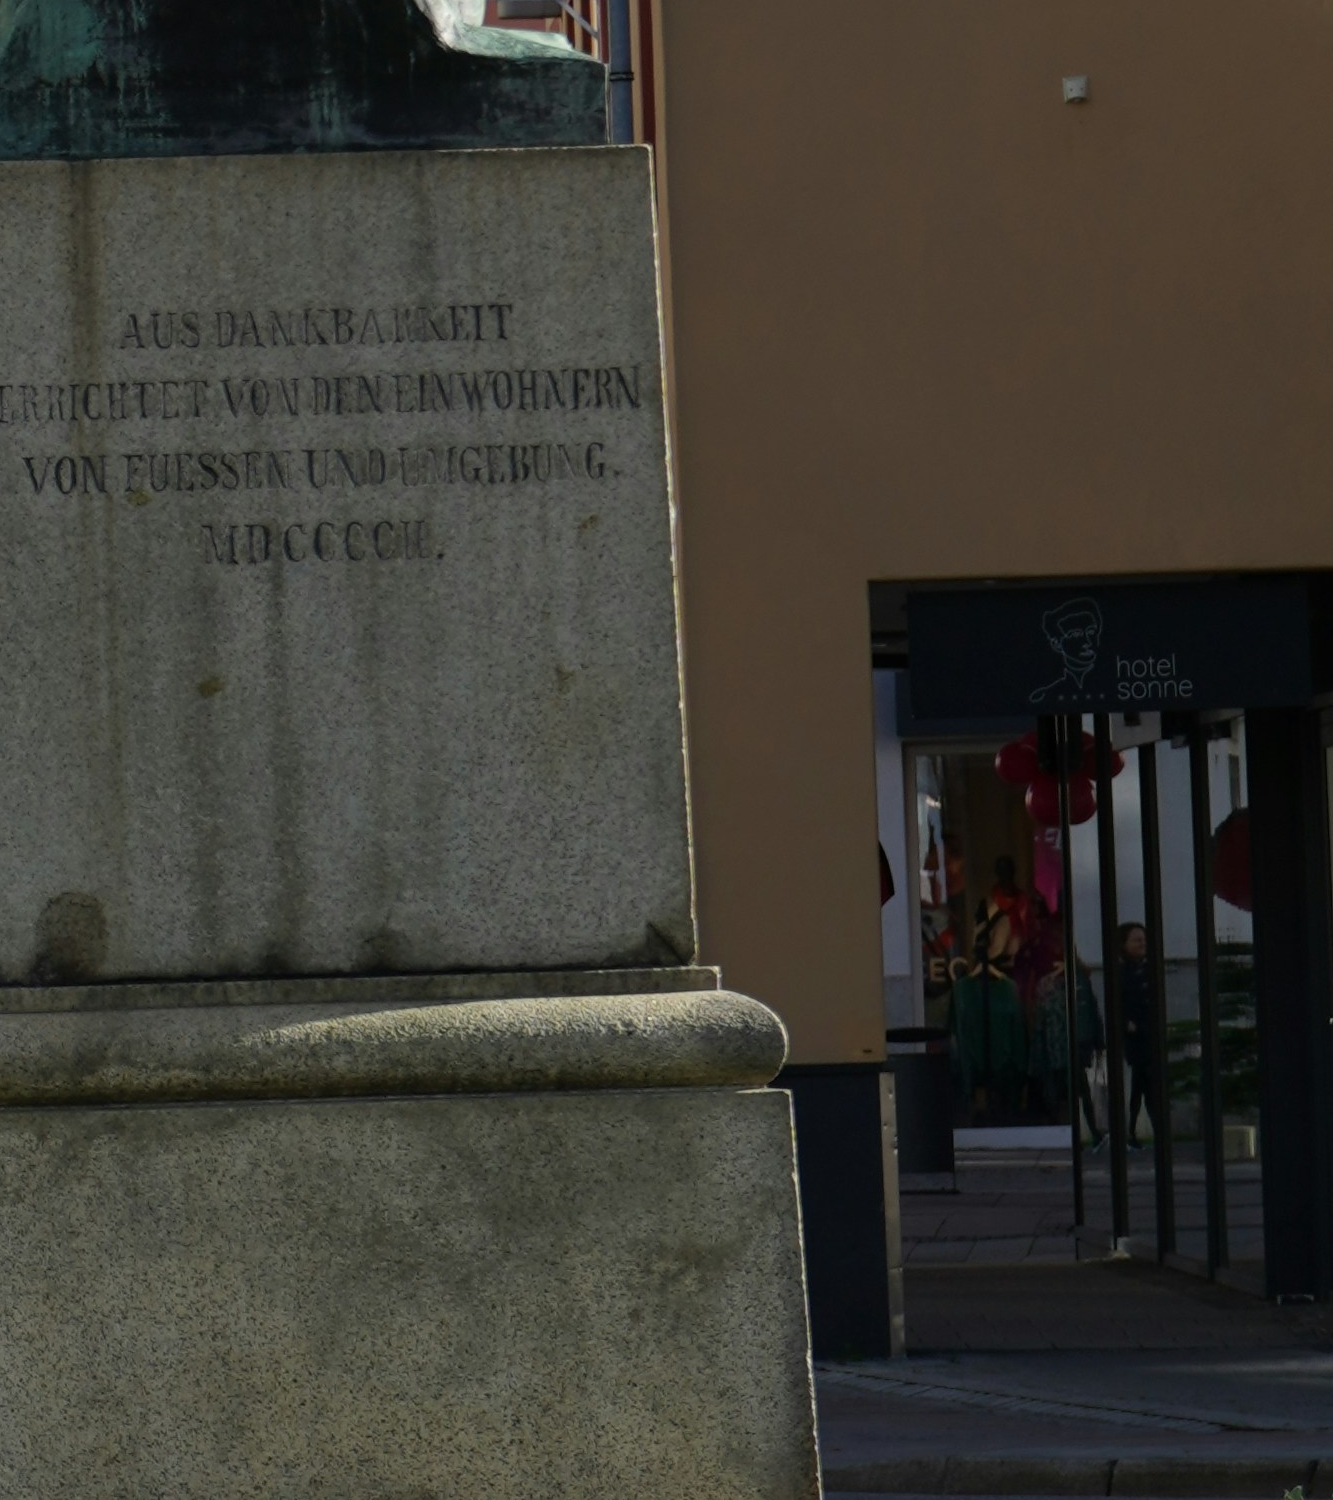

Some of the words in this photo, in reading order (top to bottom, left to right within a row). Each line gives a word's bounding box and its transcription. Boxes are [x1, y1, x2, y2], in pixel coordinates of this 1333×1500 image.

[118, 311, 201, 350] AUS
[215, 303, 514, 348] DANKBARKEIT
[219, 376, 301, 418] VON
[311, 372, 383, 417] DEN
[394, 366, 644, 415] EINWOHNERN
[21, 454, 109, 496] VON
[121, 448, 293, 493] FUESSEN
[302, 446, 387, 490] UND
[395, 440, 624, 488] UMGEBUNG.
[1117, 653, 1176, 678] hotel
[1117, 679, 1193, 700] sonne
